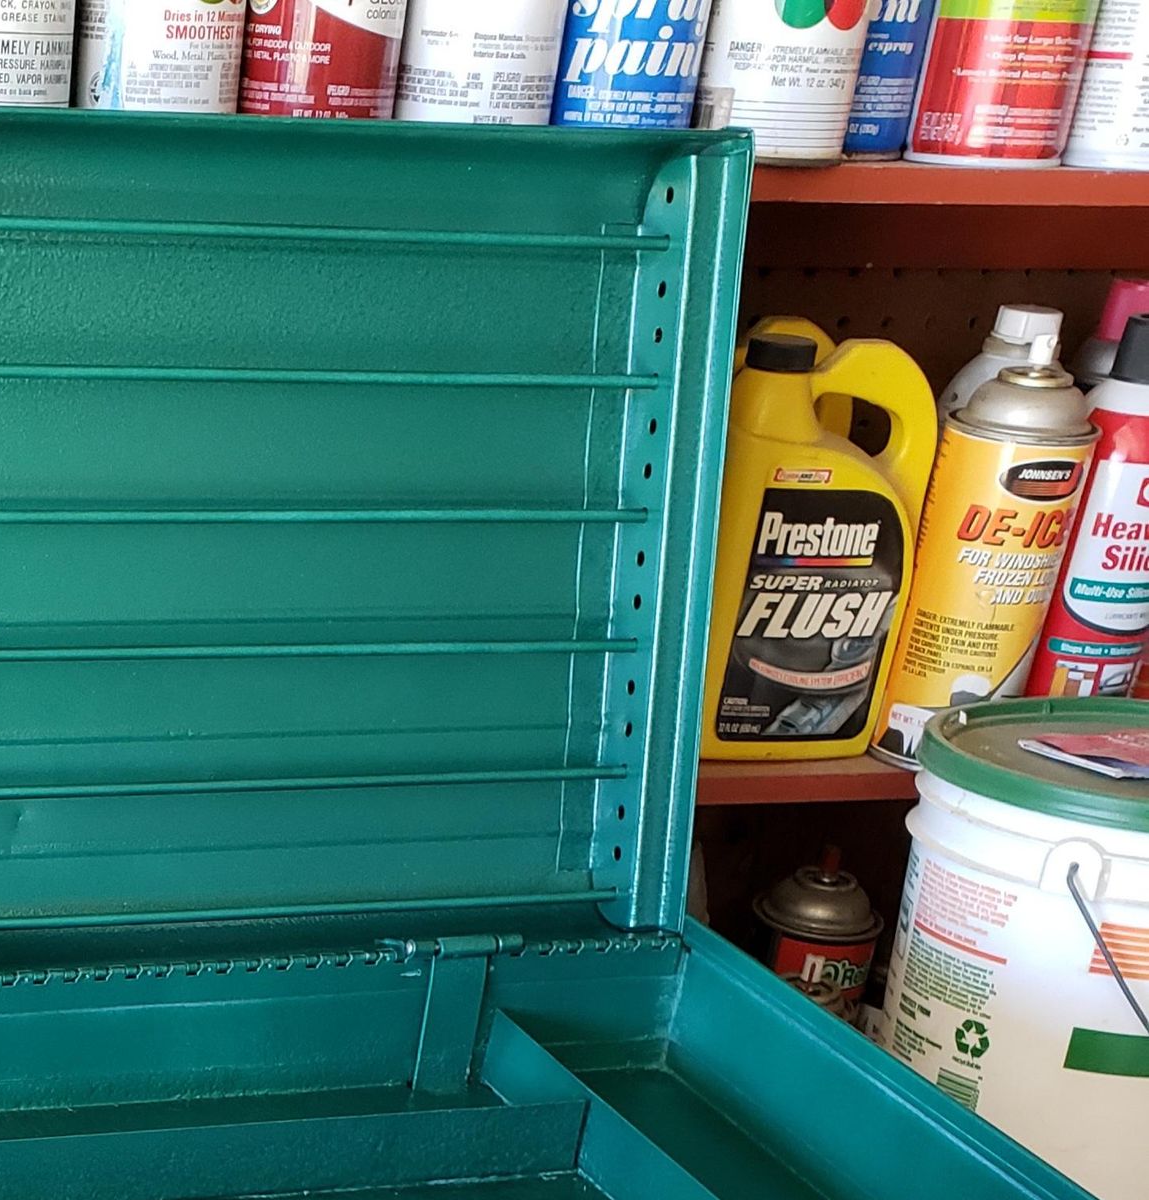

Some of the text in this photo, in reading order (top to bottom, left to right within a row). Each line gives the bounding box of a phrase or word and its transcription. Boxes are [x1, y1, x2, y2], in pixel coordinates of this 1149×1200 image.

[1, 12, 39, 23] GREASE
[164, 9, 216, 22] Dries in 12
[166, 24, 235, 40] SMOOTHEST
[153, 50, 179, 61] Wood,
[16, 73, 42, 84] VAPOR
[771, 75, 787, 87] Net
[788, 77, 803, 88] Wt.
[806, 77, 815, 88] 12
[1017, 468, 1072, 481] JOHNSEN'S
[757, 511, 880, 556] Prestone
[958, 547, 992, 567] FOR
[750, 574, 880, 592] SUPER RADIATOR
[974, 569, 1034, 588] FROZEN
[991, 589, 1024, 606] AND
[736, 591, 894, 638] FLUSH
[939, 615, 976, 629] EXTREMELY
[941, 625, 963, 637] UNDER
[941, 635, 950, 645] TO
[950, 638, 966, 647] SKIN
[967, 640, 982, 650] AND
